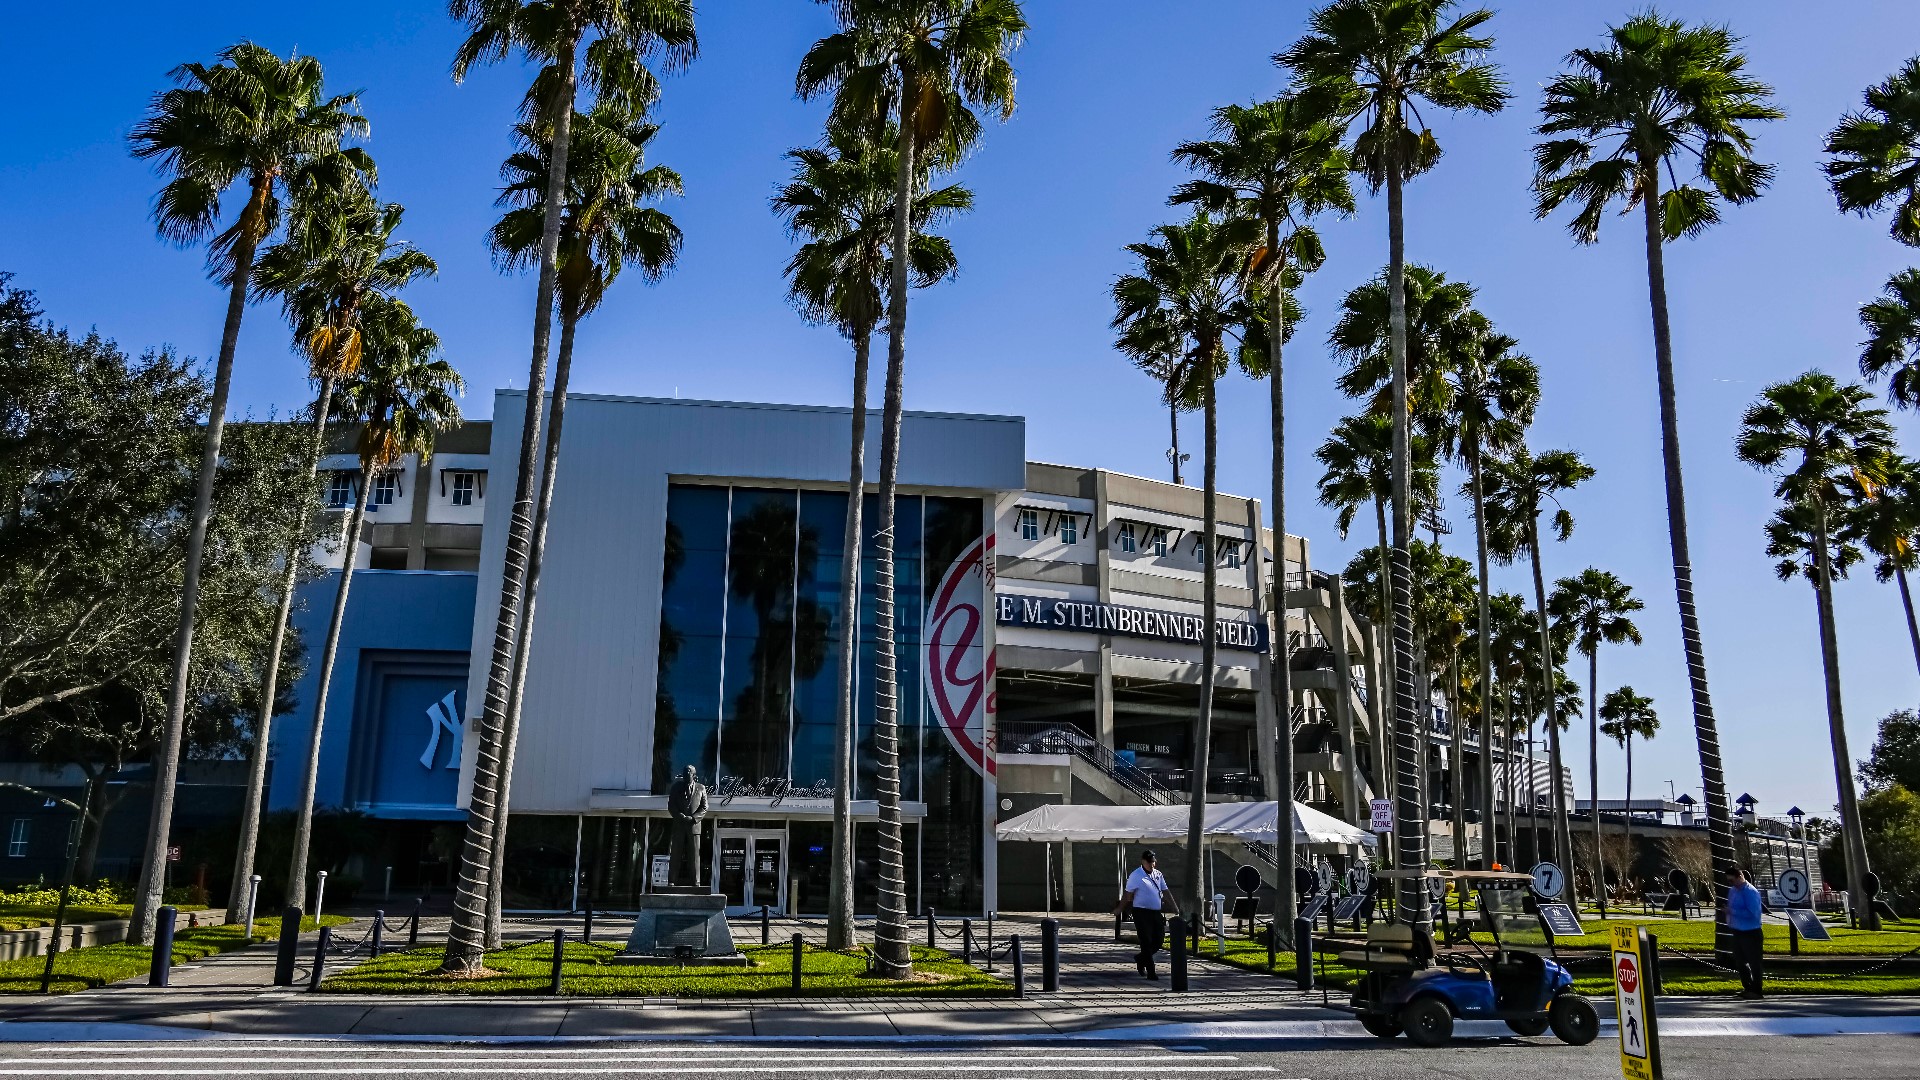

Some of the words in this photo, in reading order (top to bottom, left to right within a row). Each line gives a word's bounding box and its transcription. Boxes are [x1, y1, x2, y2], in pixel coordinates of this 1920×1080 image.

[1022, 598, 1047, 623] M.
[1054, 602, 1204, 641] STEINBRENNER
[1126, 742, 1150, 752] CHICKEN
[1154, 744, 1170, 754] FRIES
[720, 775, 769, 807] York
[770, 777, 835, 808] Yankee
[1371, 803, 1389, 811] DROP
[1375, 811, 1388, 820] OFF
[1373, 820, 1392, 828] ZONE
[1542, 870, 1553, 890] 7
[1788, 876, 1799, 894] 3
[1614, 926, 1633, 938] STATE
[1618, 939, 1631, 949] LAW
[1619, 968, 1636, 983] STOP
[1624, 996, 1635, 1006] FOR
